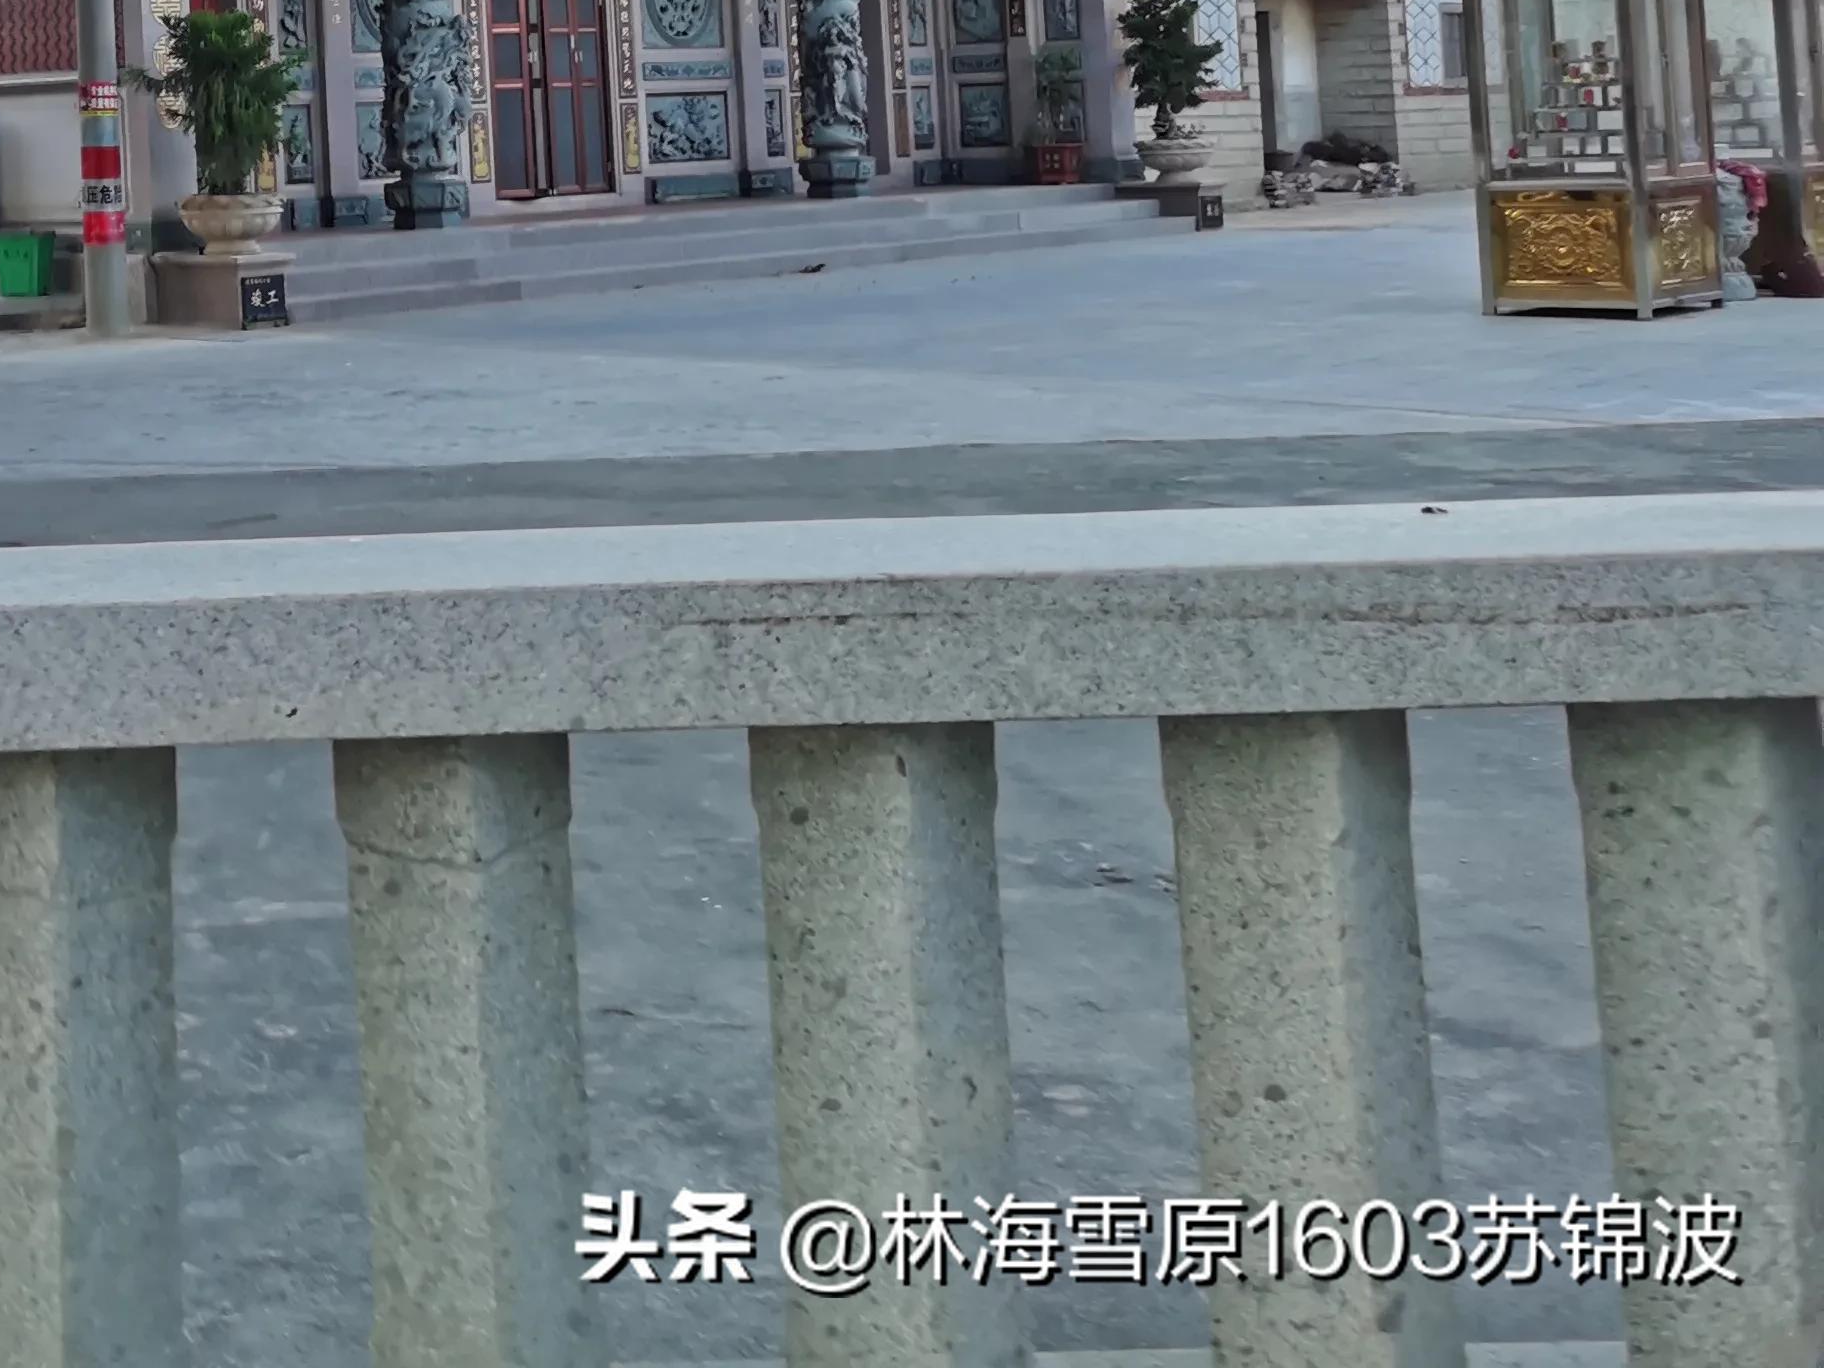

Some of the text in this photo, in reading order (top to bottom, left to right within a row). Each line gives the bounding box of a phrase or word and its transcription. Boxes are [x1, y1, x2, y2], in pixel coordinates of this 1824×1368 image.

[82, 184, 122, 205] 压危险
[250, 288, 279, 307] 竣工
